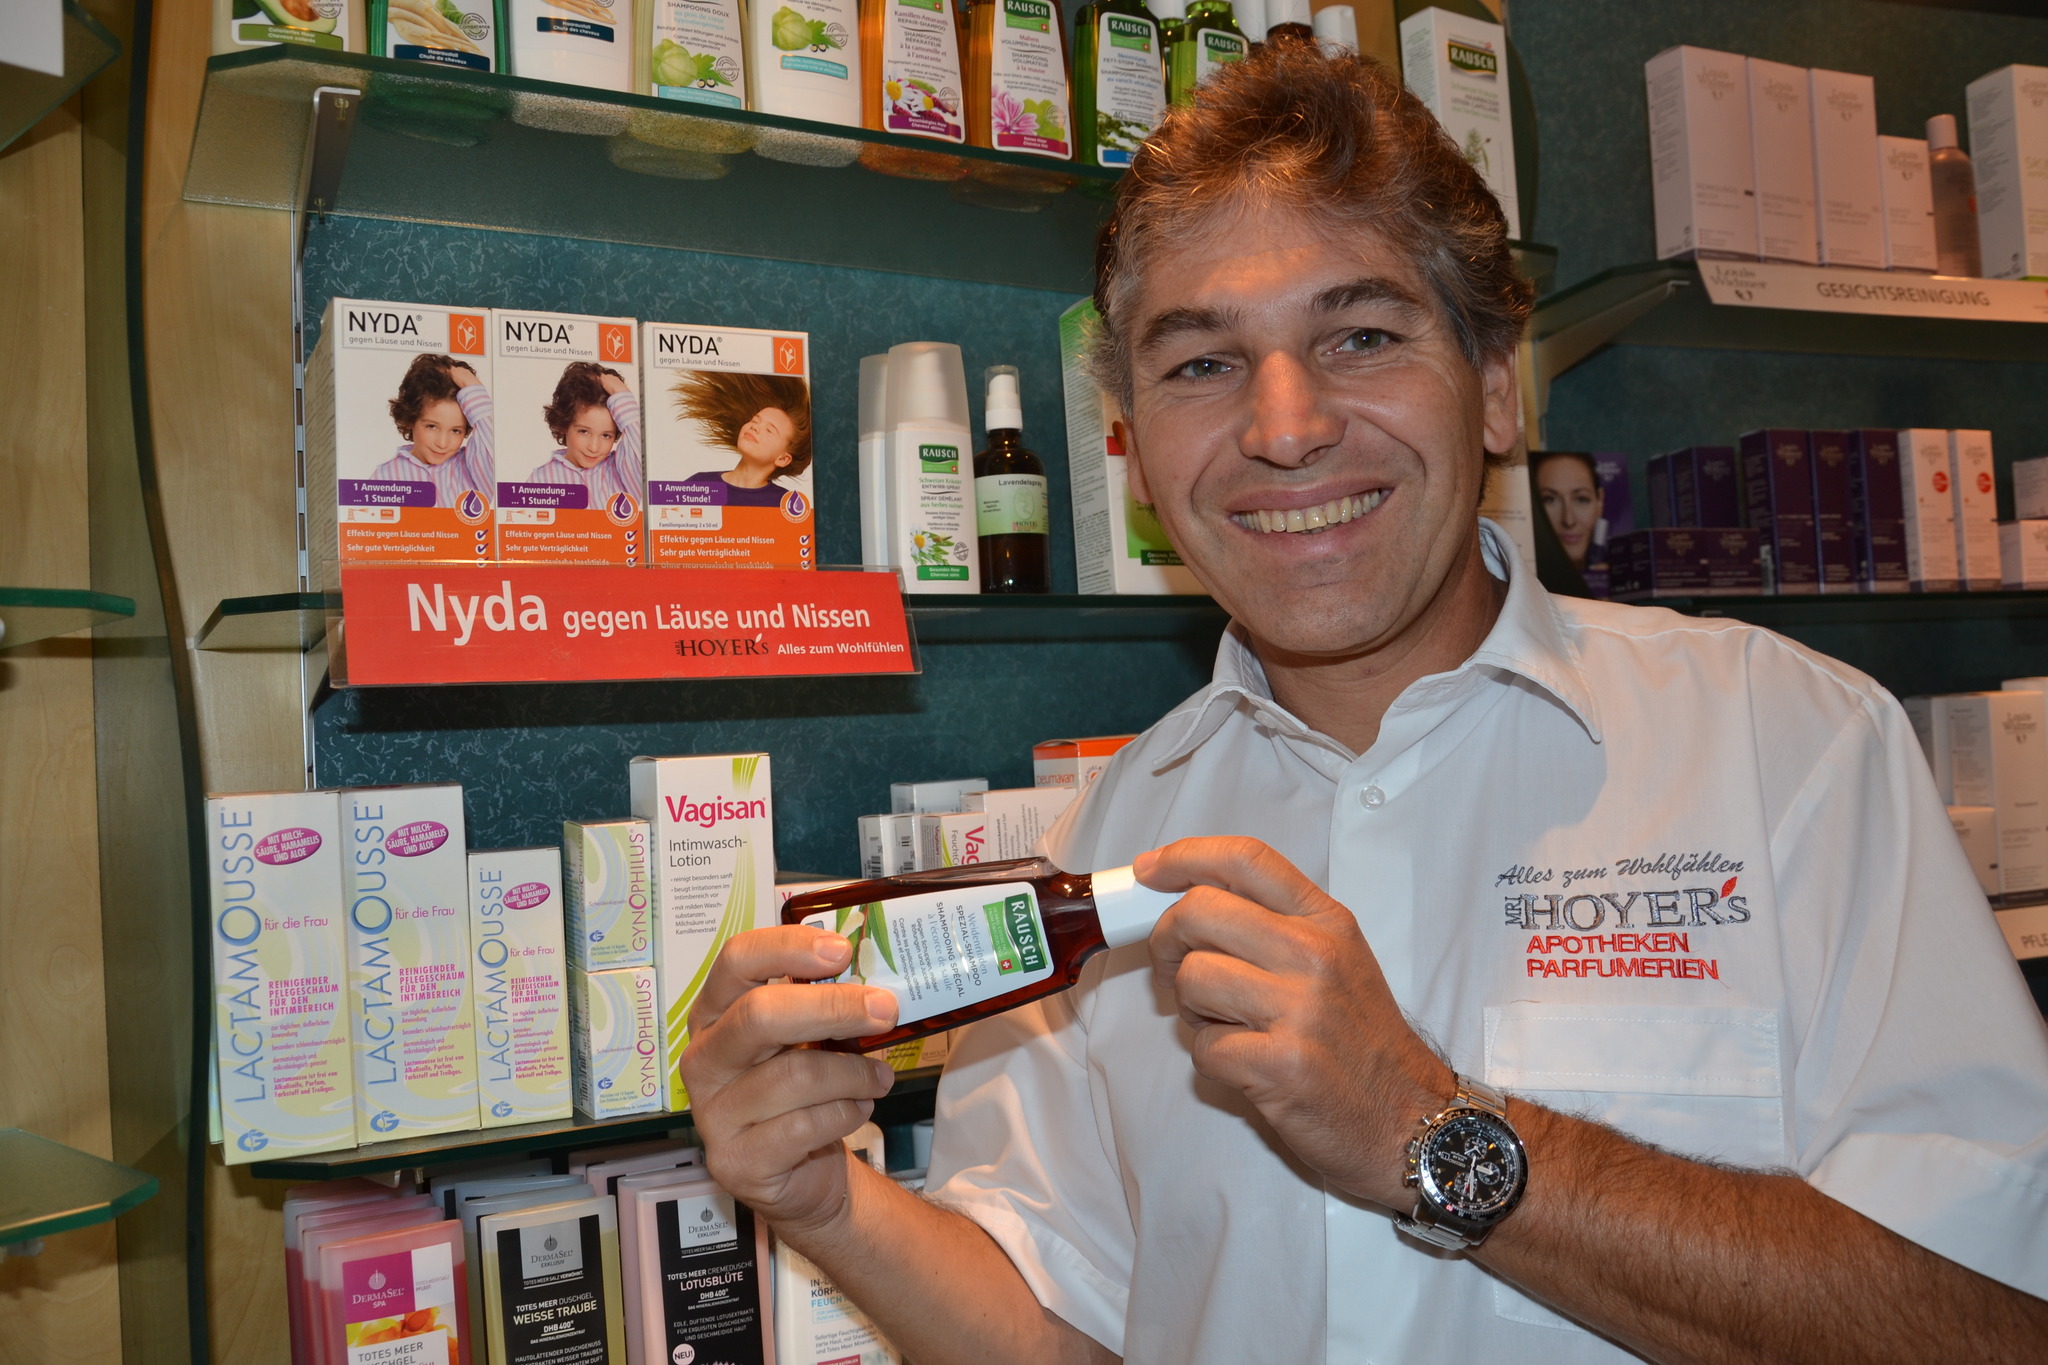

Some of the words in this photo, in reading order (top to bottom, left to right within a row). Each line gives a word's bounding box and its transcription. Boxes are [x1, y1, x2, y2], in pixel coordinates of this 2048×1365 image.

[667, 2, 711, 13] SHAMPOOING
[712, 8, 729, 18] DOUX
[1007, 1, 1047, 16] RAUSCH
[1111, 20, 1149, 36] RAUSCH
[1207, 37, 1241, 51] RAUSCH
[1451, 47, 1494, 70] RAUSCH
[1817, 281, 1990, 307] GESICHTSREINIGUNG
[375, 337, 399, 345] Läuse
[400, 338, 415, 346] und
[416, 339, 443, 348] Nissen
[530, 345, 552, 353] Läuse
[568, 348, 593, 356] Nissen
[659, 357, 681, 365] gegen
[682, 357, 702, 365] Läuse
[922, 448, 957, 458] RAUSCH
[361, 484, 412, 494] Anwendung
[665, 485, 710, 494] Anwendung
[998, 479, 1043, 488] Lavendelspray
[519, 486, 566, 496] Anwendung
[372, 495, 405, 503] Stunde!
[528, 497, 560, 505] Stunde!
[682, 495, 711, 503] Stunde!
[347, 530, 375, 538] Effektiv
[715, 536, 735, 544] Läuse
[347, 544, 363, 552] Sehr
[383, 544, 436, 553] Verträglichkeit
[540, 545, 588, 553] Verträglichkeit
[678, 550, 696, 558] gute
[698, 548, 750, 557] Verträglichkeit
[407, 580, 548, 646] Nyda
[563, 610, 647, 638] gegen
[655, 603, 729, 630] Läuse
[736, 603, 785, 629] und
[791, 603, 871, 628] Nissen
[777, 643, 806, 655] Alles
[809, 644, 834, 655] zum
[837, 642, 904, 654] Wohlfühlen
[664, 795, 766, 828] Vagisan
[267, 835, 280, 845] MIT
[398, 828, 409, 838] MIT
[410, 828, 447, 844] HAMAMELIS
[281, 835, 320, 852] HAMAMELIS
[403, 845, 418, 855] UND
[419, 841, 435, 852] ALOE
[669, 835, 747, 852] Intimwasch-
[274, 852, 289, 863] UND
[290, 848, 307, 859] ALOE
[670, 854, 711, 867] Lotion
[1494, 864, 1555, 888] Alles
[1562, 868, 1607, 888] zum
[1616, 850, 1744, 880] Wohlfühlen
[628, 829, 647, 952] GYNOPHILUS
[395, 908, 408, 920] für
[412, 906, 429, 918] die
[432, 905, 455, 917] Frau
[264, 918, 278, 930] für
[282, 916, 300, 929] die
[304, 916, 328, 928] Frau
[675, 927, 717, 935] Kamillenextrakt
[1011, 900, 1038, 966] RAUSCH
[351, 801, 396, 1085] LACTAMOUSSE
[936, 902, 955, 960] SHAMPOOING
[950, 963, 965, 998] SPÉCIAL
[956, 904, 982, 986] SPEZIAL-SHAMPOO
[968, 913, 988, 974] Weidenrinden
[1526, 932, 1690, 954] APOTHEKEN
[217, 807, 266, 1103] LACTAMOUSSE
[400, 964, 456, 976] REINIGENDER
[478, 868, 512, 1082] LACTAMOUSSE
[1526, 958, 1720, 980] PARFUMERIEN
[269, 976, 329, 989] REINIGENDER
[400, 971, 465, 984] PFLEGESCHAUM
[941, 968, 952, 991] saule
[269, 984, 339, 998] PFLEGESCHAUM
[400, 983, 416, 993] FÜR
[420, 982, 437, 991] DEN
[270, 997, 286, 1007] FÜR
[291, 996, 309, 1005] DEN
[400, 989, 461, 1002] INTIMBEREICH
[270, 1003, 334, 1016] INTIMBEREICH
[636, 976, 656, 1098] GYNOPHILUS
[541, 1260, 565, 1268] EXKLUSIV
[667, 1272, 687, 1281] TOTES
[688, 1269, 707, 1278] MEER
[708, 1260, 753, 1275] CREMEDUSCHE
[680, 1271, 744, 1291] LOTUSBLÜTE
[516, 1302, 538, 1312] TOTES
[538, 1299, 558, 1309] MEER
[559, 1292, 593, 1305] DUSCHGEL
[513, 1310, 554, 1325] WEISSE
[556, 1300, 598, 1316] TRAUBE
[358, 1347, 391, 1362] TOTES
[395, 1342, 423, 1356] MEER
[674, 1350, 693, 1360] NEU!
